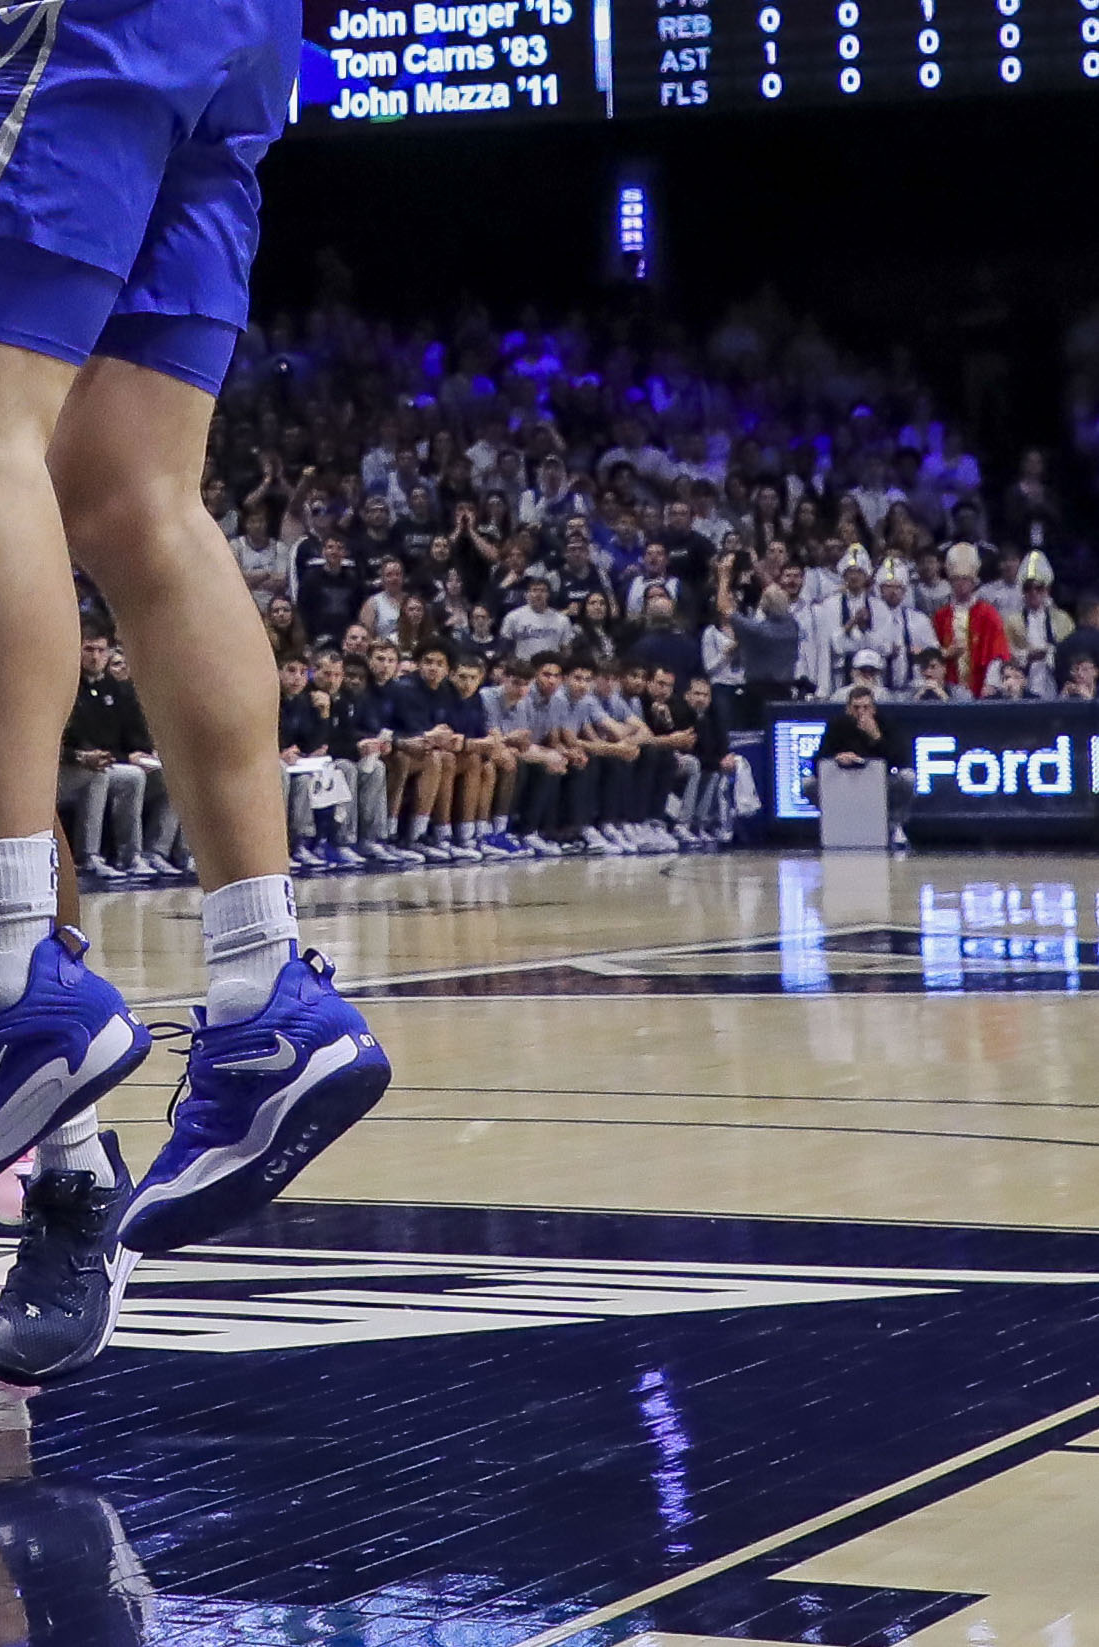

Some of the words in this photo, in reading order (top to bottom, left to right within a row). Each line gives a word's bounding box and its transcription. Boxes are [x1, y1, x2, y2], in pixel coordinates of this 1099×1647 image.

[330, 8, 406, 40] John
[414, 1, 519, 37] Burger
[658, 14, 711, 41] REB
[759, 6, 781, 32] 0
[838, 0, 859, 28] 0
[331, 48, 397, 79] Tom
[403, 44, 494, 73] Carns
[500, 35, 547, 66] '83
[660, 46, 711, 72] AST
[764, 40, 777, 65] 1
[839, 34, 860, 60] 0
[918, 28, 940, 54] 0
[999, 23, 1020, 49] 0
[1081, 16, 1099, 43] 0
[331, 89, 408, 119] John
[415, 82, 509, 113] Mazza
[517, 74, 558, 105] '11
[660, 80, 709, 106] FLS
[761, 72, 782, 98] 0
[840, 66, 861, 93] 0
[918, 61, 941, 88] 0
[1000, 55, 1022, 83] 0
[1082, 50, 1099, 78] 0
[914, 735, 1074, 795] Ford
